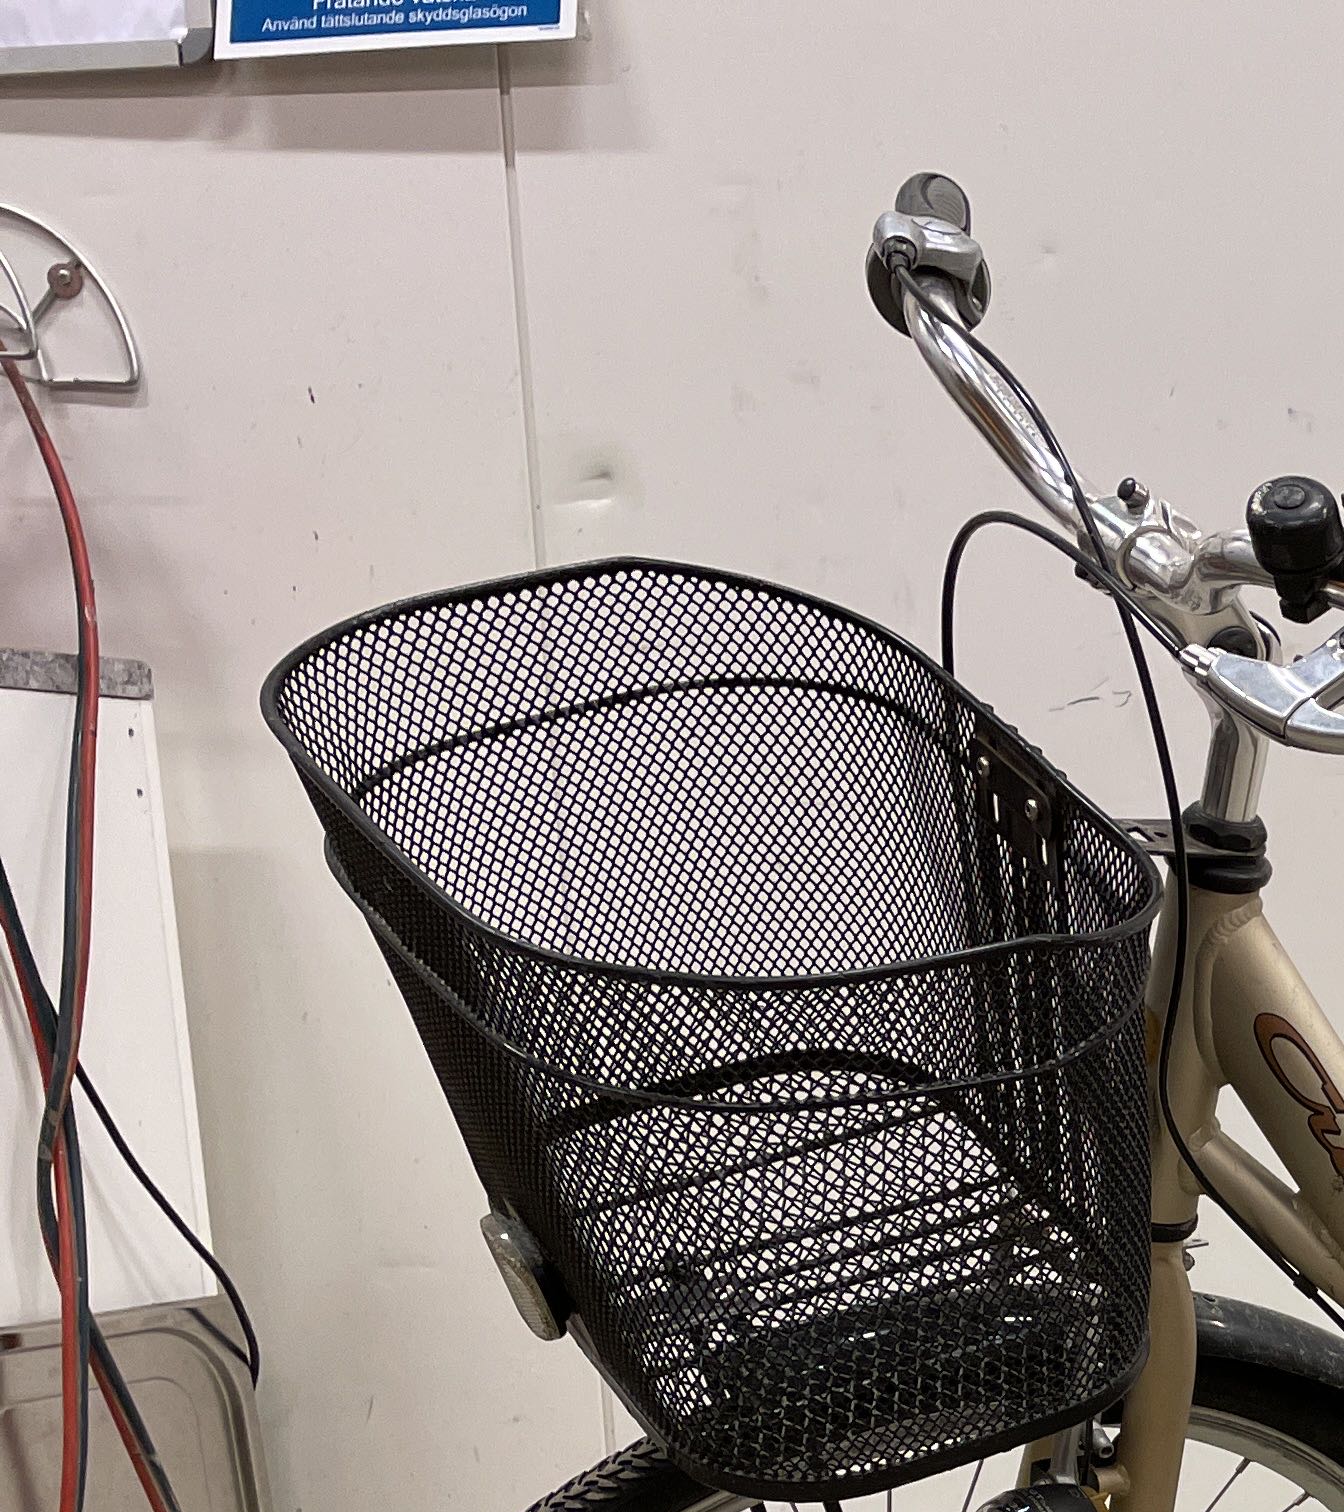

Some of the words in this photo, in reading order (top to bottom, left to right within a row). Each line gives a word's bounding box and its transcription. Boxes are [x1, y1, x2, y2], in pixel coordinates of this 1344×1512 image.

[261, 15, 318, 33] Använd
[321, 10, 405, 29] tättslutande
[408, 4, 528, 26] skyddsglasögon
